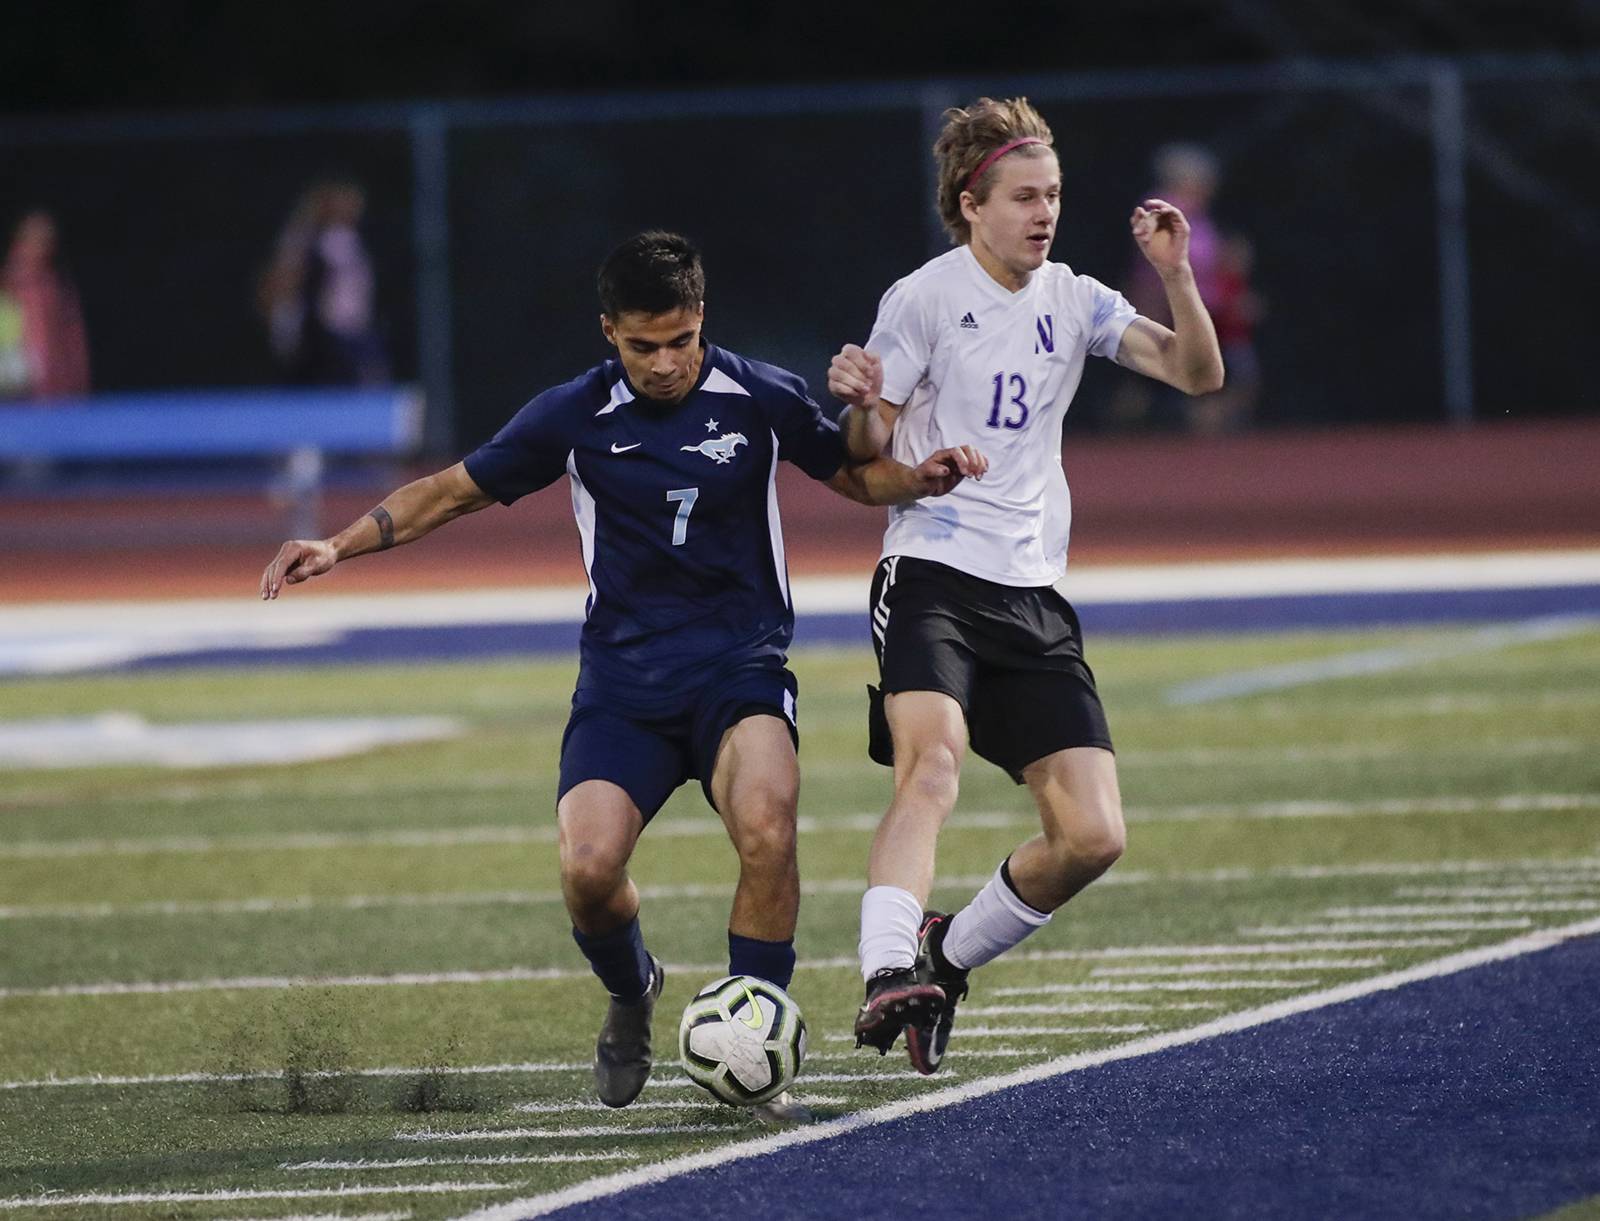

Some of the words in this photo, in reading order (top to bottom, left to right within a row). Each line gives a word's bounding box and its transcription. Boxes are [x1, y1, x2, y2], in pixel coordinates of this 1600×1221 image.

[1035, 314, 1054, 354] N
[986, 371, 1028, 430] 13
[666, 487, 699, 546] 7
